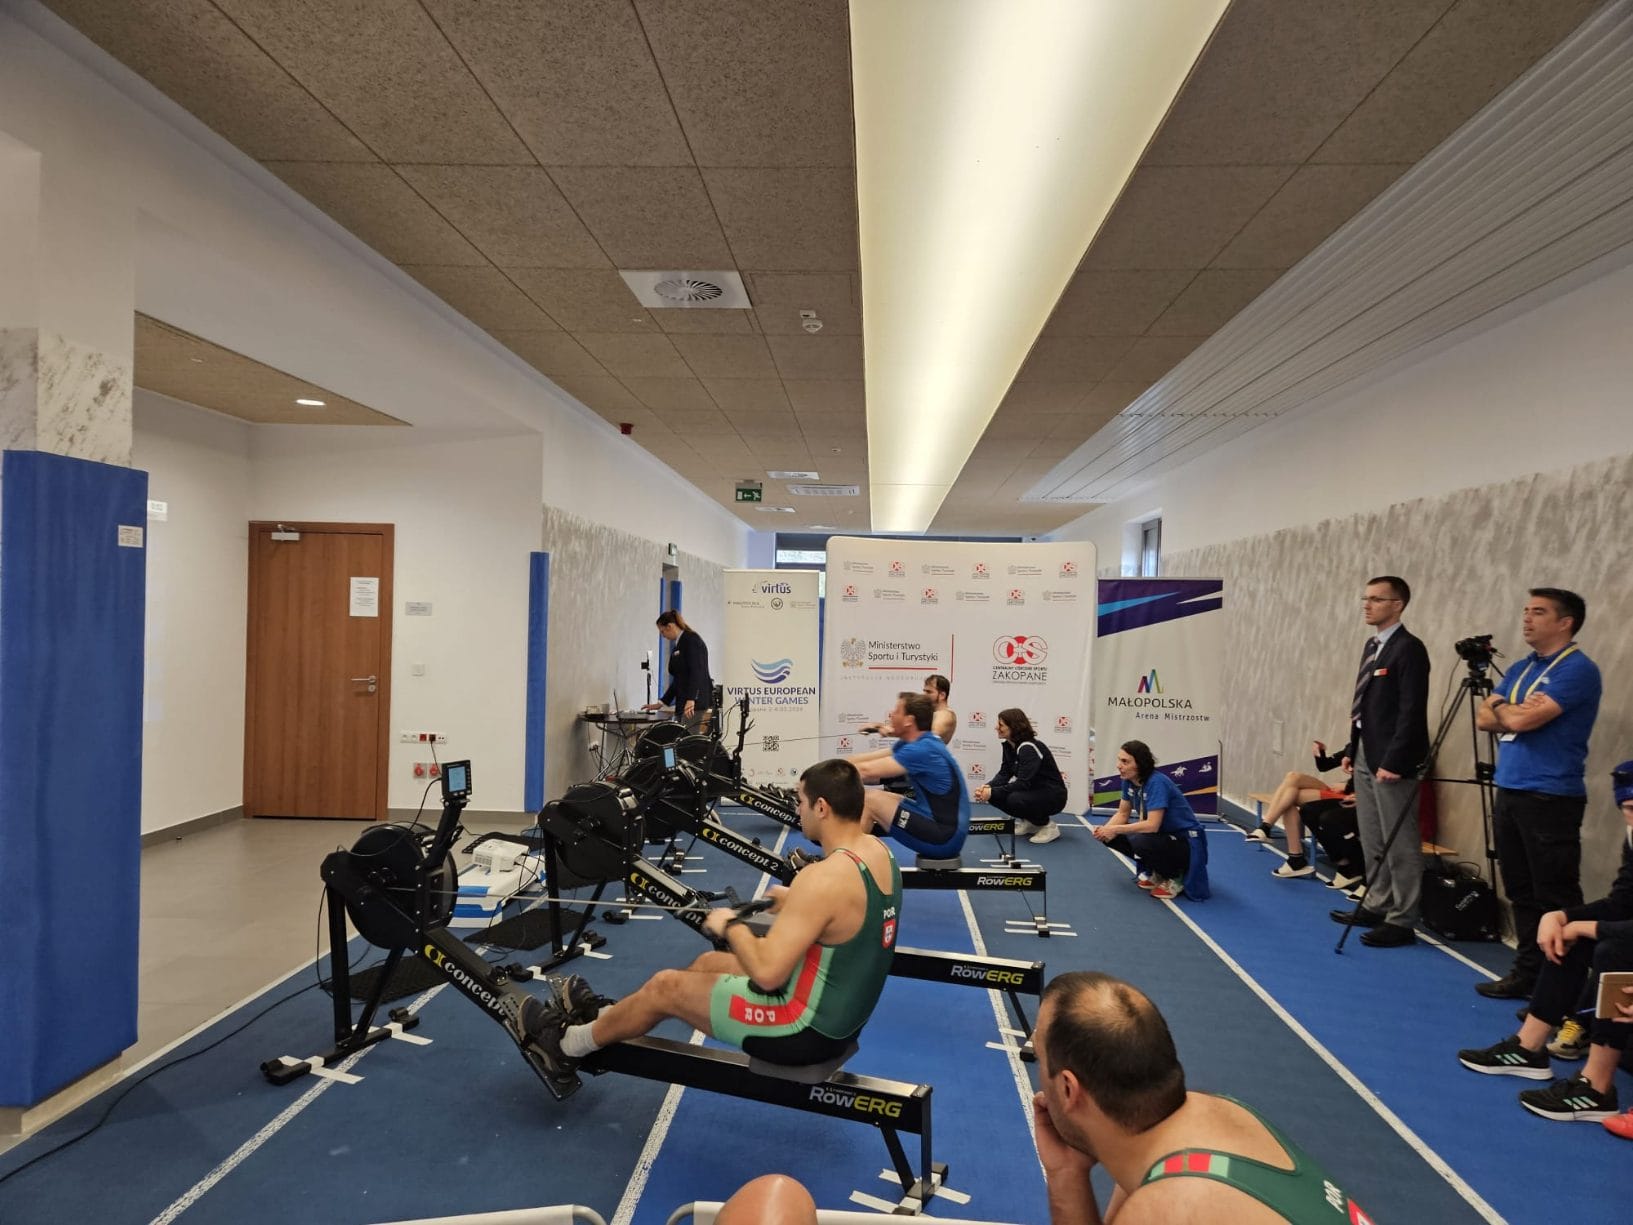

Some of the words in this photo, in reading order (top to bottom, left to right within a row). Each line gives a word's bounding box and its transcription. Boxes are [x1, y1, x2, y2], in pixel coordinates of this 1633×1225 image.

[868, 640, 921, 650] Ministerstwo
[868, 651, 894, 661] Sportu
[901, 652, 938, 662] Turystyki
[992, 670, 1048, 681] ZAKOPANE
[727, 687, 762, 695] VIRTUS
[764, 687, 816, 695] EUROPEAN
[735, 696, 773, 705] WNTER
[775, 697, 809, 705] GAMES
[1107, 696, 1193, 709] MAŁOPOLSKA
[1135, 712, 1159, 720] Arena
[1164, 713, 1210, 721] Mistrzostw
[968, 822, 1005, 831] owERG
[719, 837, 771, 868] concept
[770, 861, 779, 871] 2
[883, 906, 896, 919] POR
[744, 1007, 776, 1023] POR
[1323, 1180, 1345, 1214] POR
